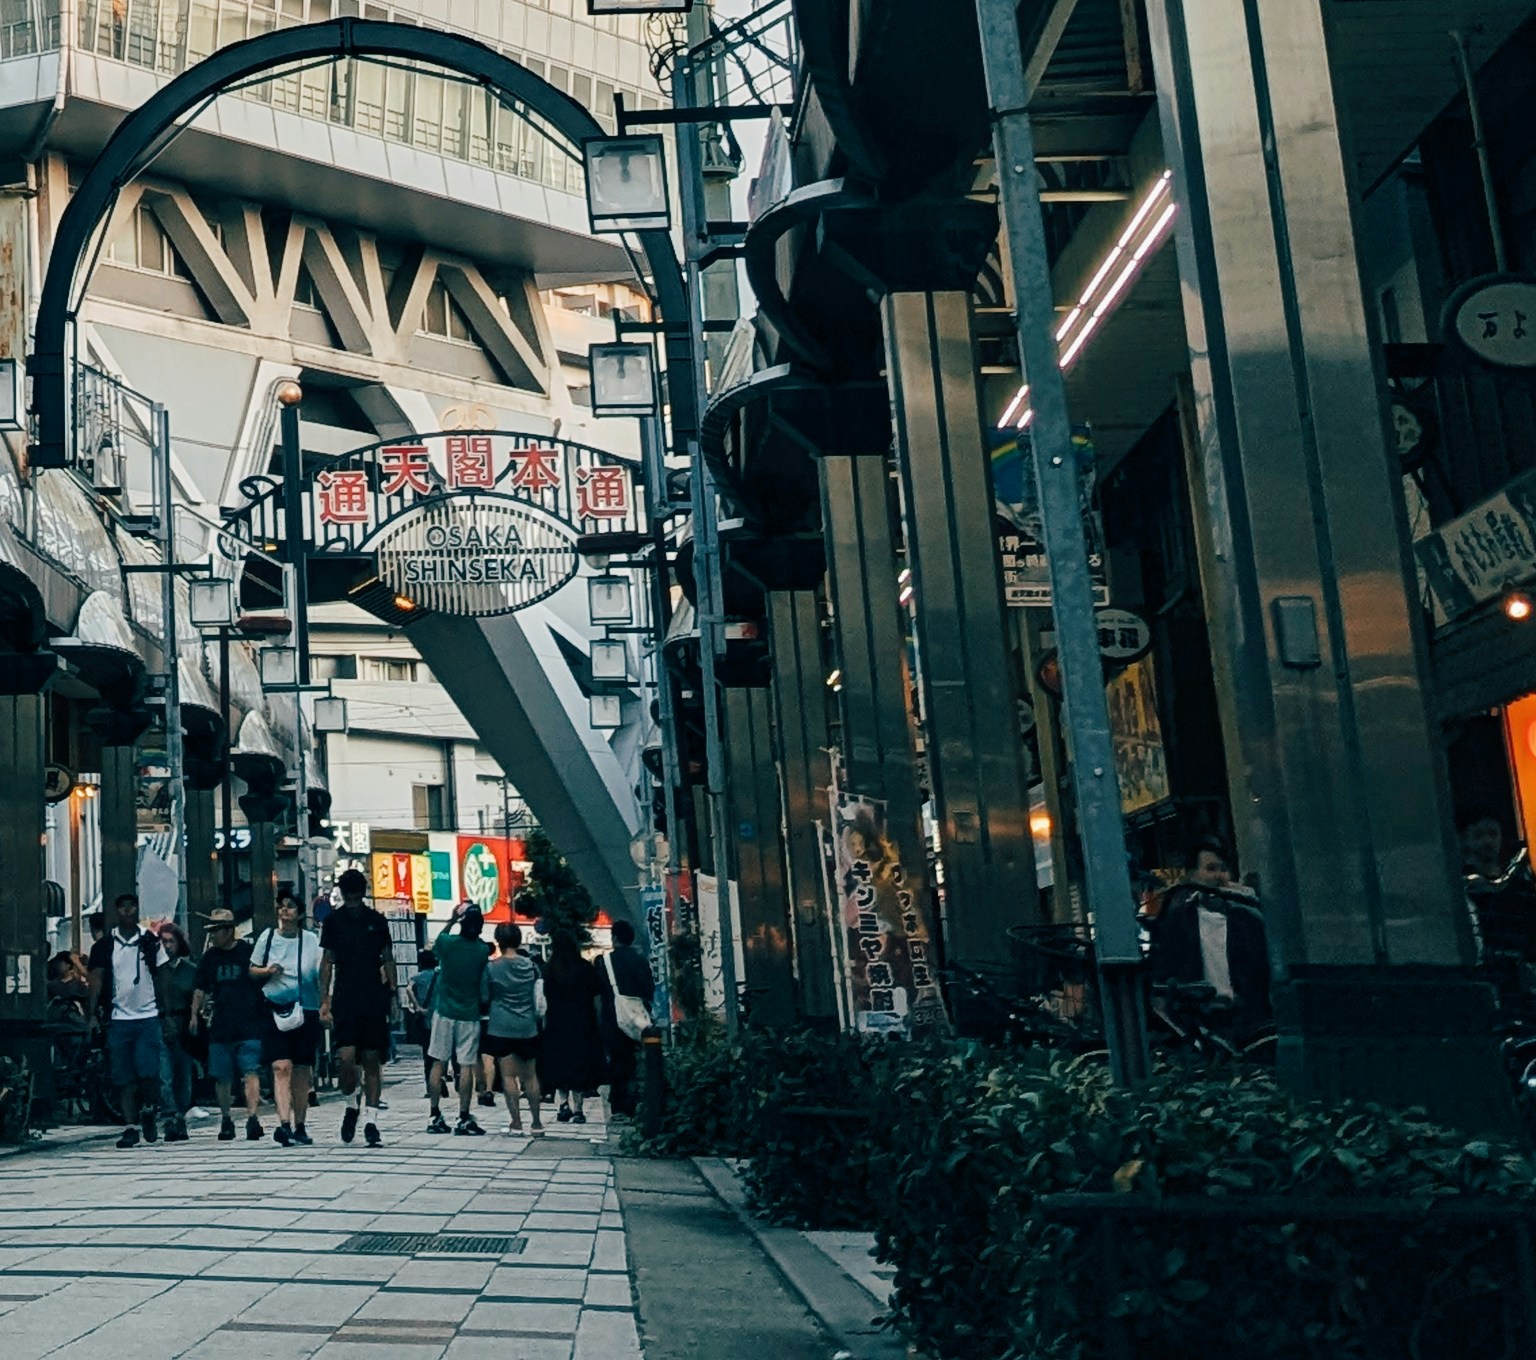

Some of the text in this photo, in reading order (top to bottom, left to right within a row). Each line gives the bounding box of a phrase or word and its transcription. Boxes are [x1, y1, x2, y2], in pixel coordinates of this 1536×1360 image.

[317, 436, 629, 524] 通天閣本通
[425, 524, 524, 549] OSAKA
[405, 556, 547, 585] SHINSEKAI
